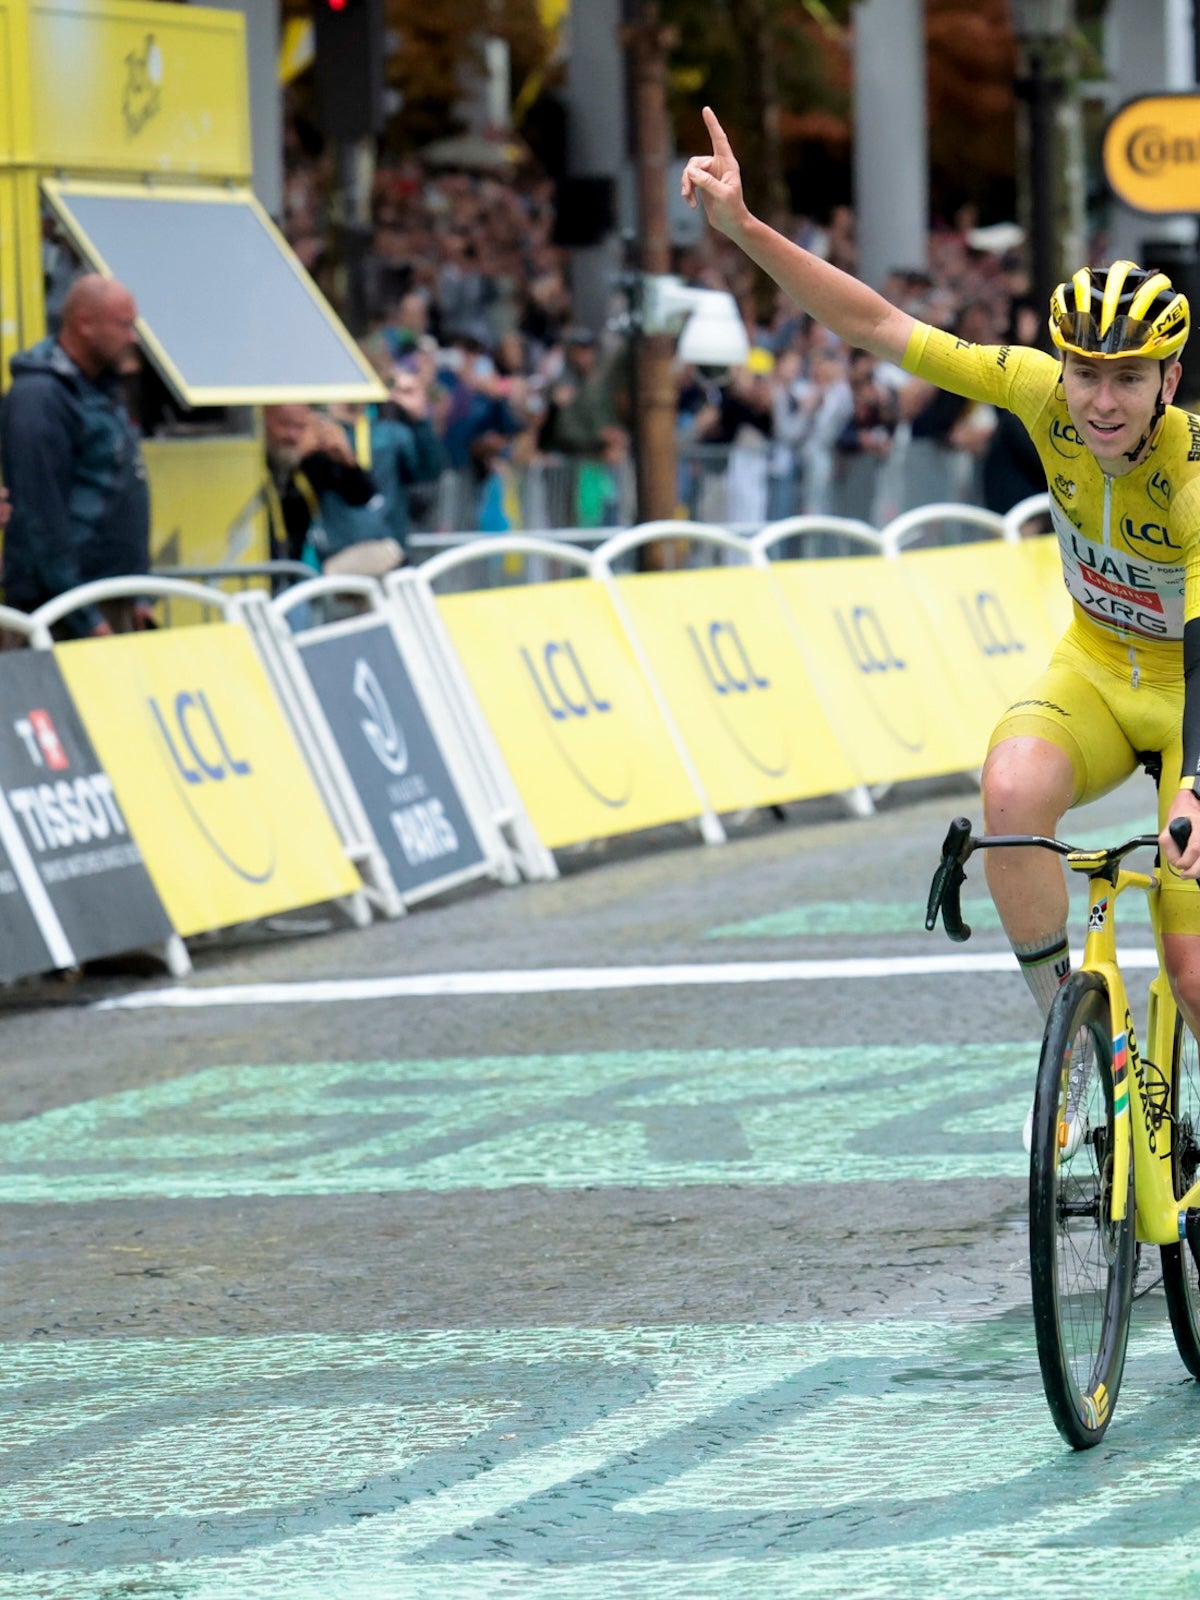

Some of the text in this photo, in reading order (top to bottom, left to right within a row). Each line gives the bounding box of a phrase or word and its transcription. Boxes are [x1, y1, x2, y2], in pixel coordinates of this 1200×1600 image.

[1156, 301, 1184, 332] MET
[1071, 533, 1156, 590] UAE
[1126, 518, 1183, 549] LCL
[1083, 587, 1169, 634] XRG
[1086, 569, 1154, 605] Emirates
[687, 620, 770, 695] LCL
[833, 605, 907, 675] LCL
[519, 639, 612, 721] LCL
[147, 689, 252, 784] LCL
[9, 772, 126, 852] TISSOT
[390, 797, 460, 867] PARIS
[1125, 1007, 1157, 1154] COLNAGO
